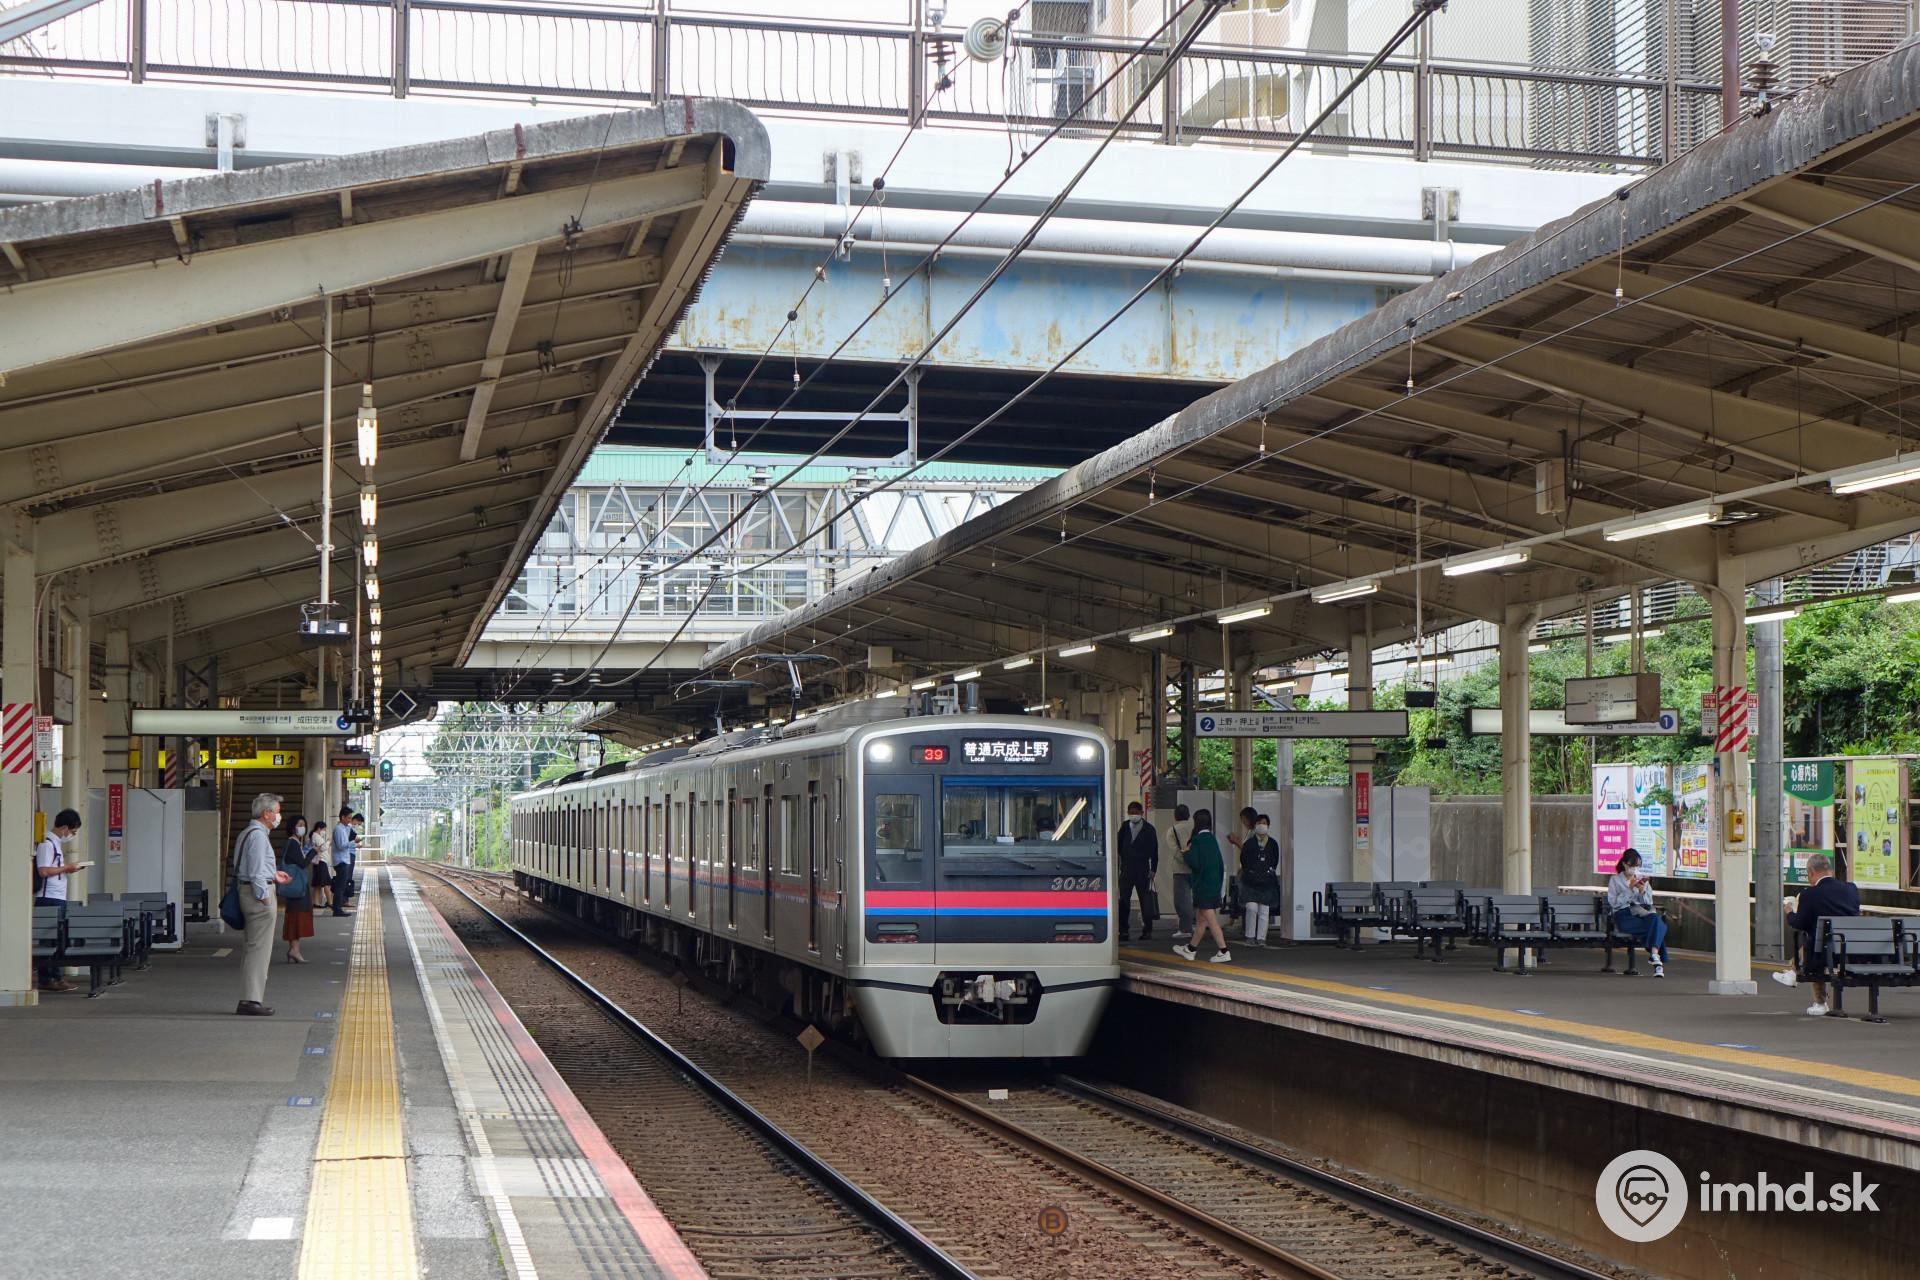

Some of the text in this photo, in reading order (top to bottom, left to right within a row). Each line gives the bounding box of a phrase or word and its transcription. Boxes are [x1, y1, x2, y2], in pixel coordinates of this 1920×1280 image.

[1203, 719, 1212, 730] 2
[924, 748, 944, 760] 39
[1790, 764, 1818, 782] 心療内科
[1051, 876, 1102, 891] 3034
[1046, 1213, 1060, 1229] B
